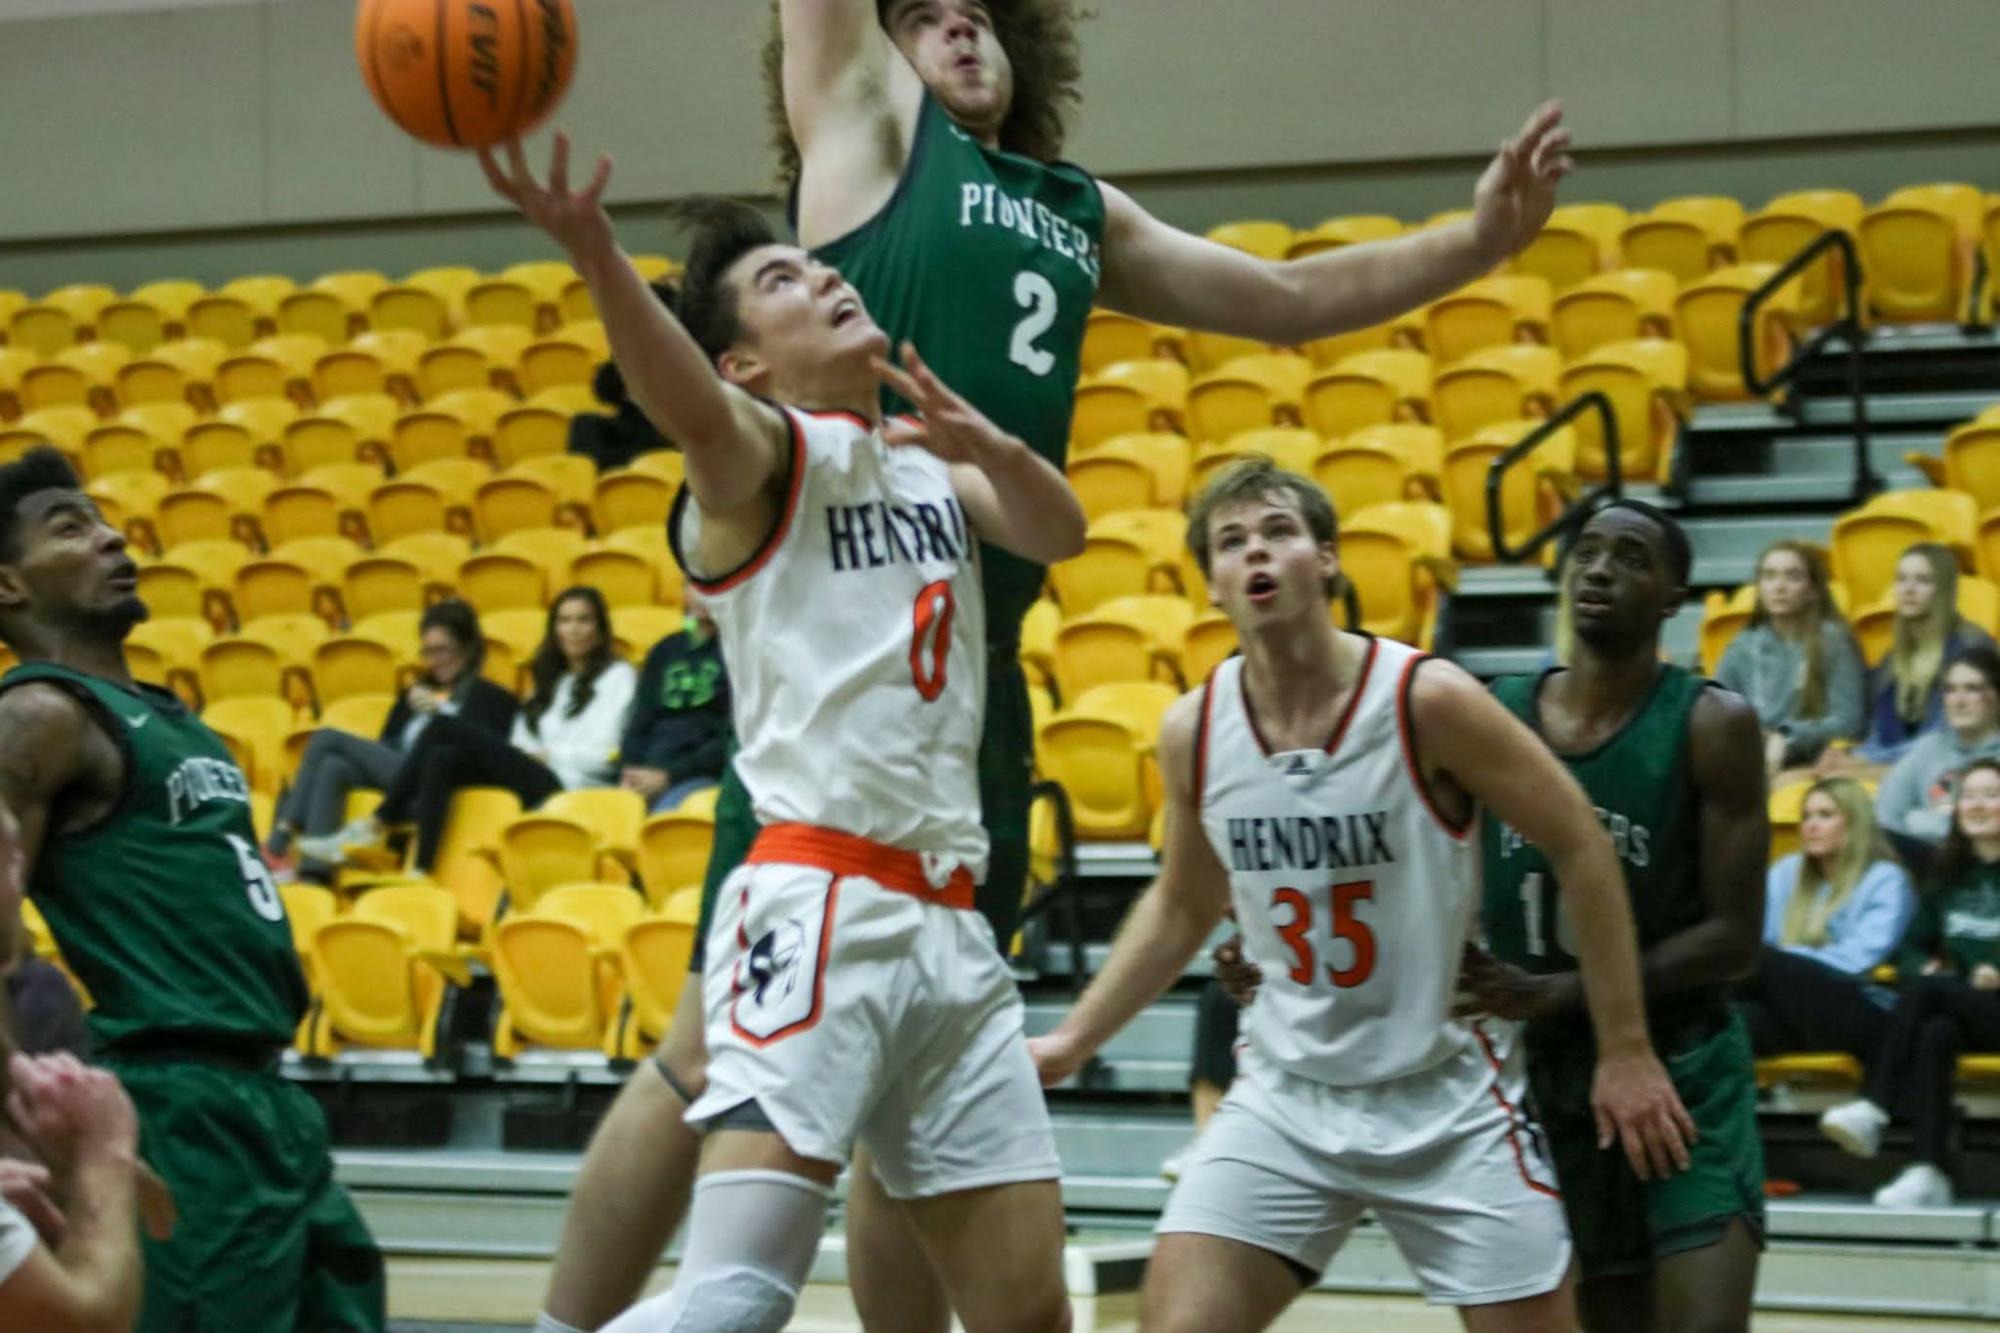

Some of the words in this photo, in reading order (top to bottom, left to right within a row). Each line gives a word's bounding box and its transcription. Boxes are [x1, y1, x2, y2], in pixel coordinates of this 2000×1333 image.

[1009, 270, 1058, 377] 2
[826, 498, 972, 572] HENDRI
[908, 578, 956, 704] 0
[224, 832, 284, 922] 5
[1226, 811, 1397, 872] HENDRIX
[1269, 879, 1380, 989] 35
